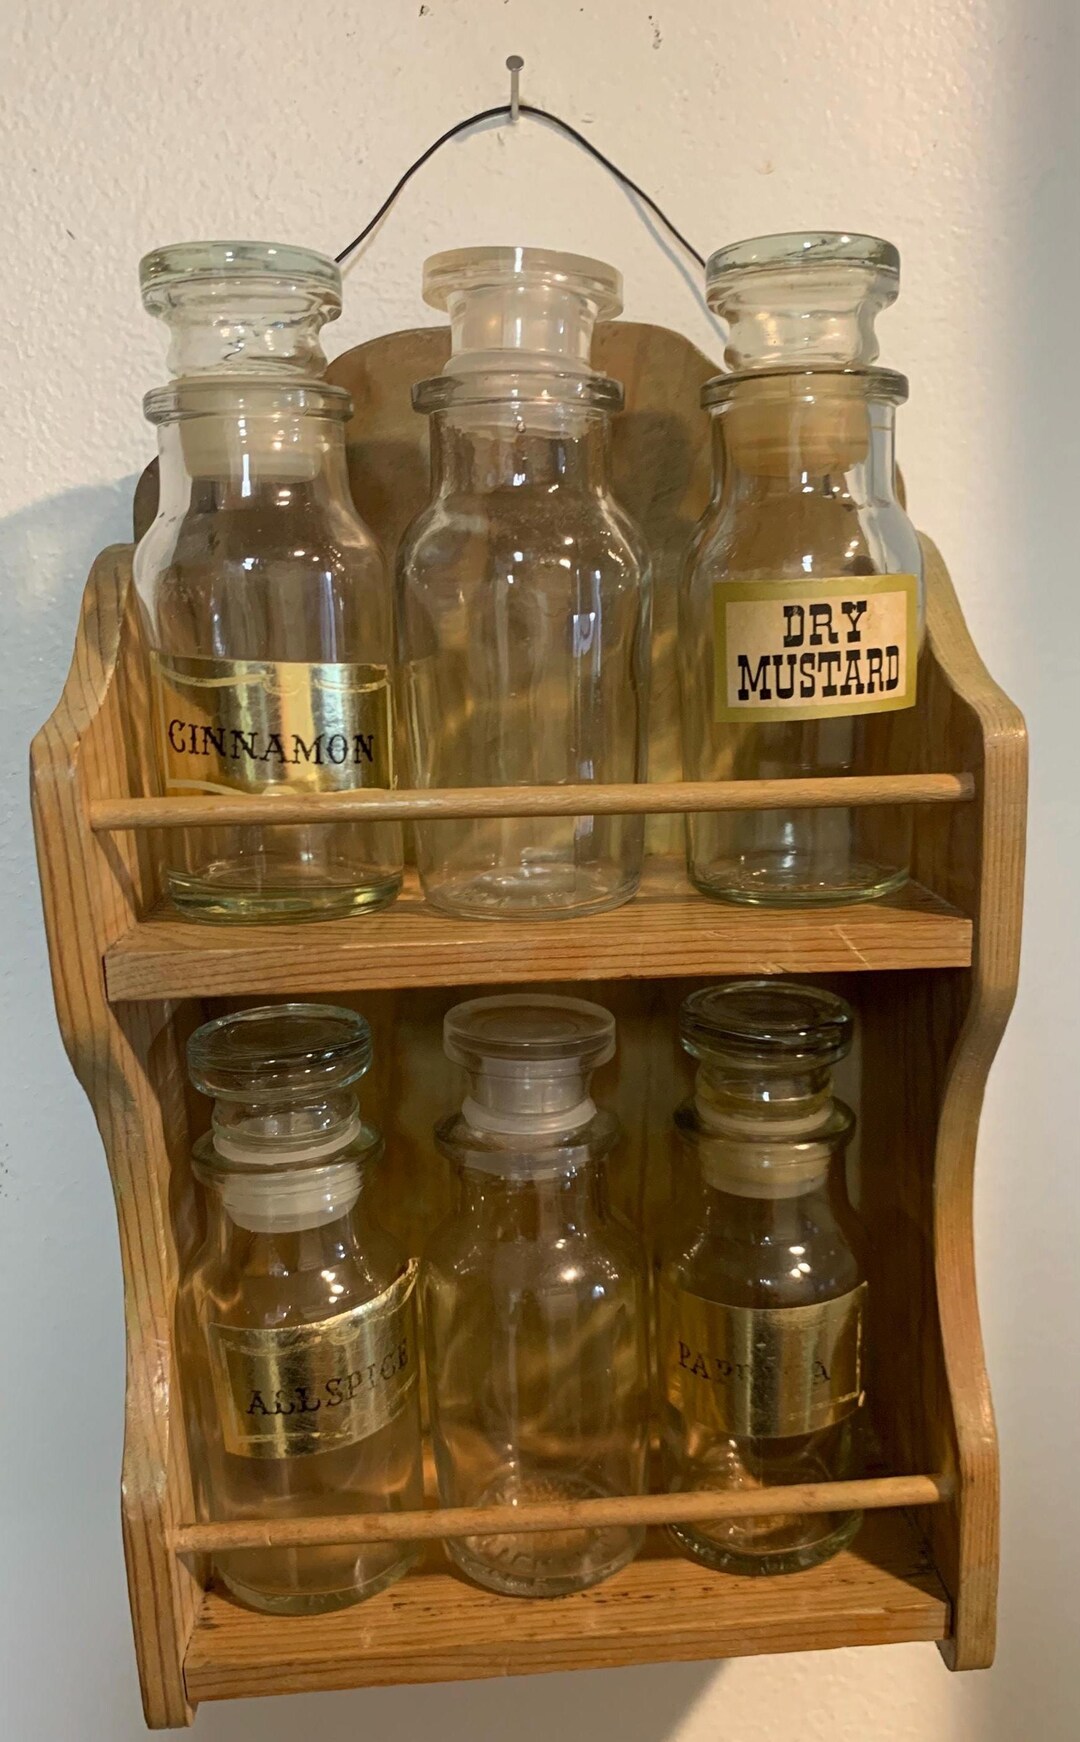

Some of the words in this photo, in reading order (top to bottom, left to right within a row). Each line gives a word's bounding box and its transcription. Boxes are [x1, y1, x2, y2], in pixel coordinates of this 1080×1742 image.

[783, 600, 867, 648] DRY
[737, 645, 899, 701] MUSTARD
[168, 719, 374, 765] CINNAMON
